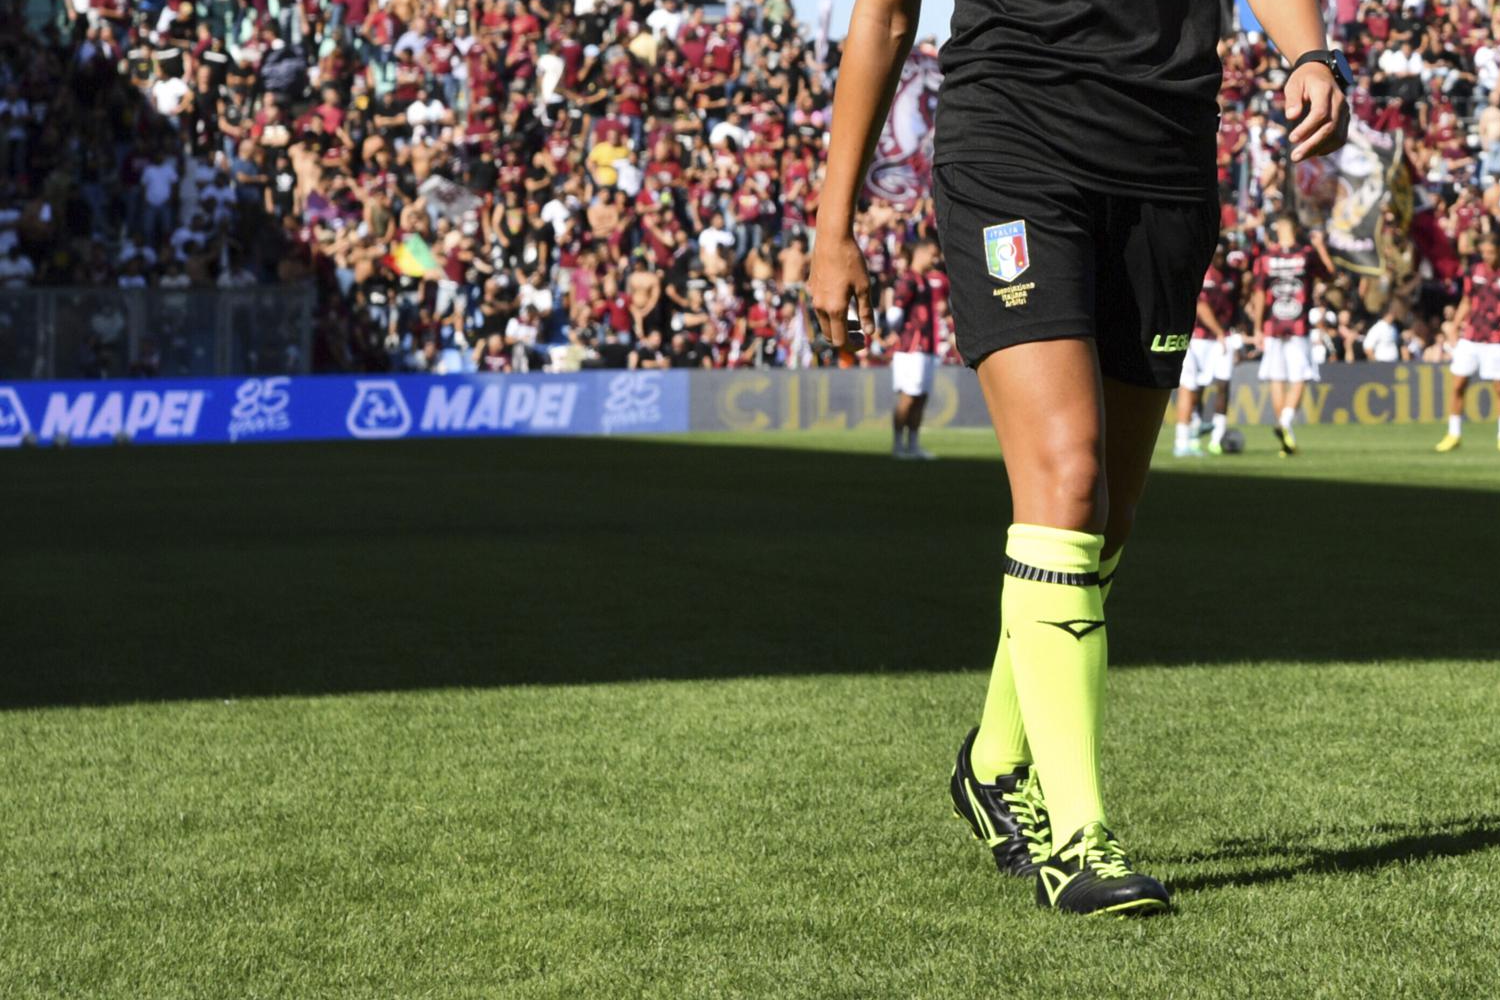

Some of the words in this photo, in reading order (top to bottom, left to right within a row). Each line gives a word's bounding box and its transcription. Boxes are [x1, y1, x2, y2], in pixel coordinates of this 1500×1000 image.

[40, 391, 206, 438] MAPEI
[231, 376, 292, 418] 85
[420, 384, 580, 431] MAPEI
